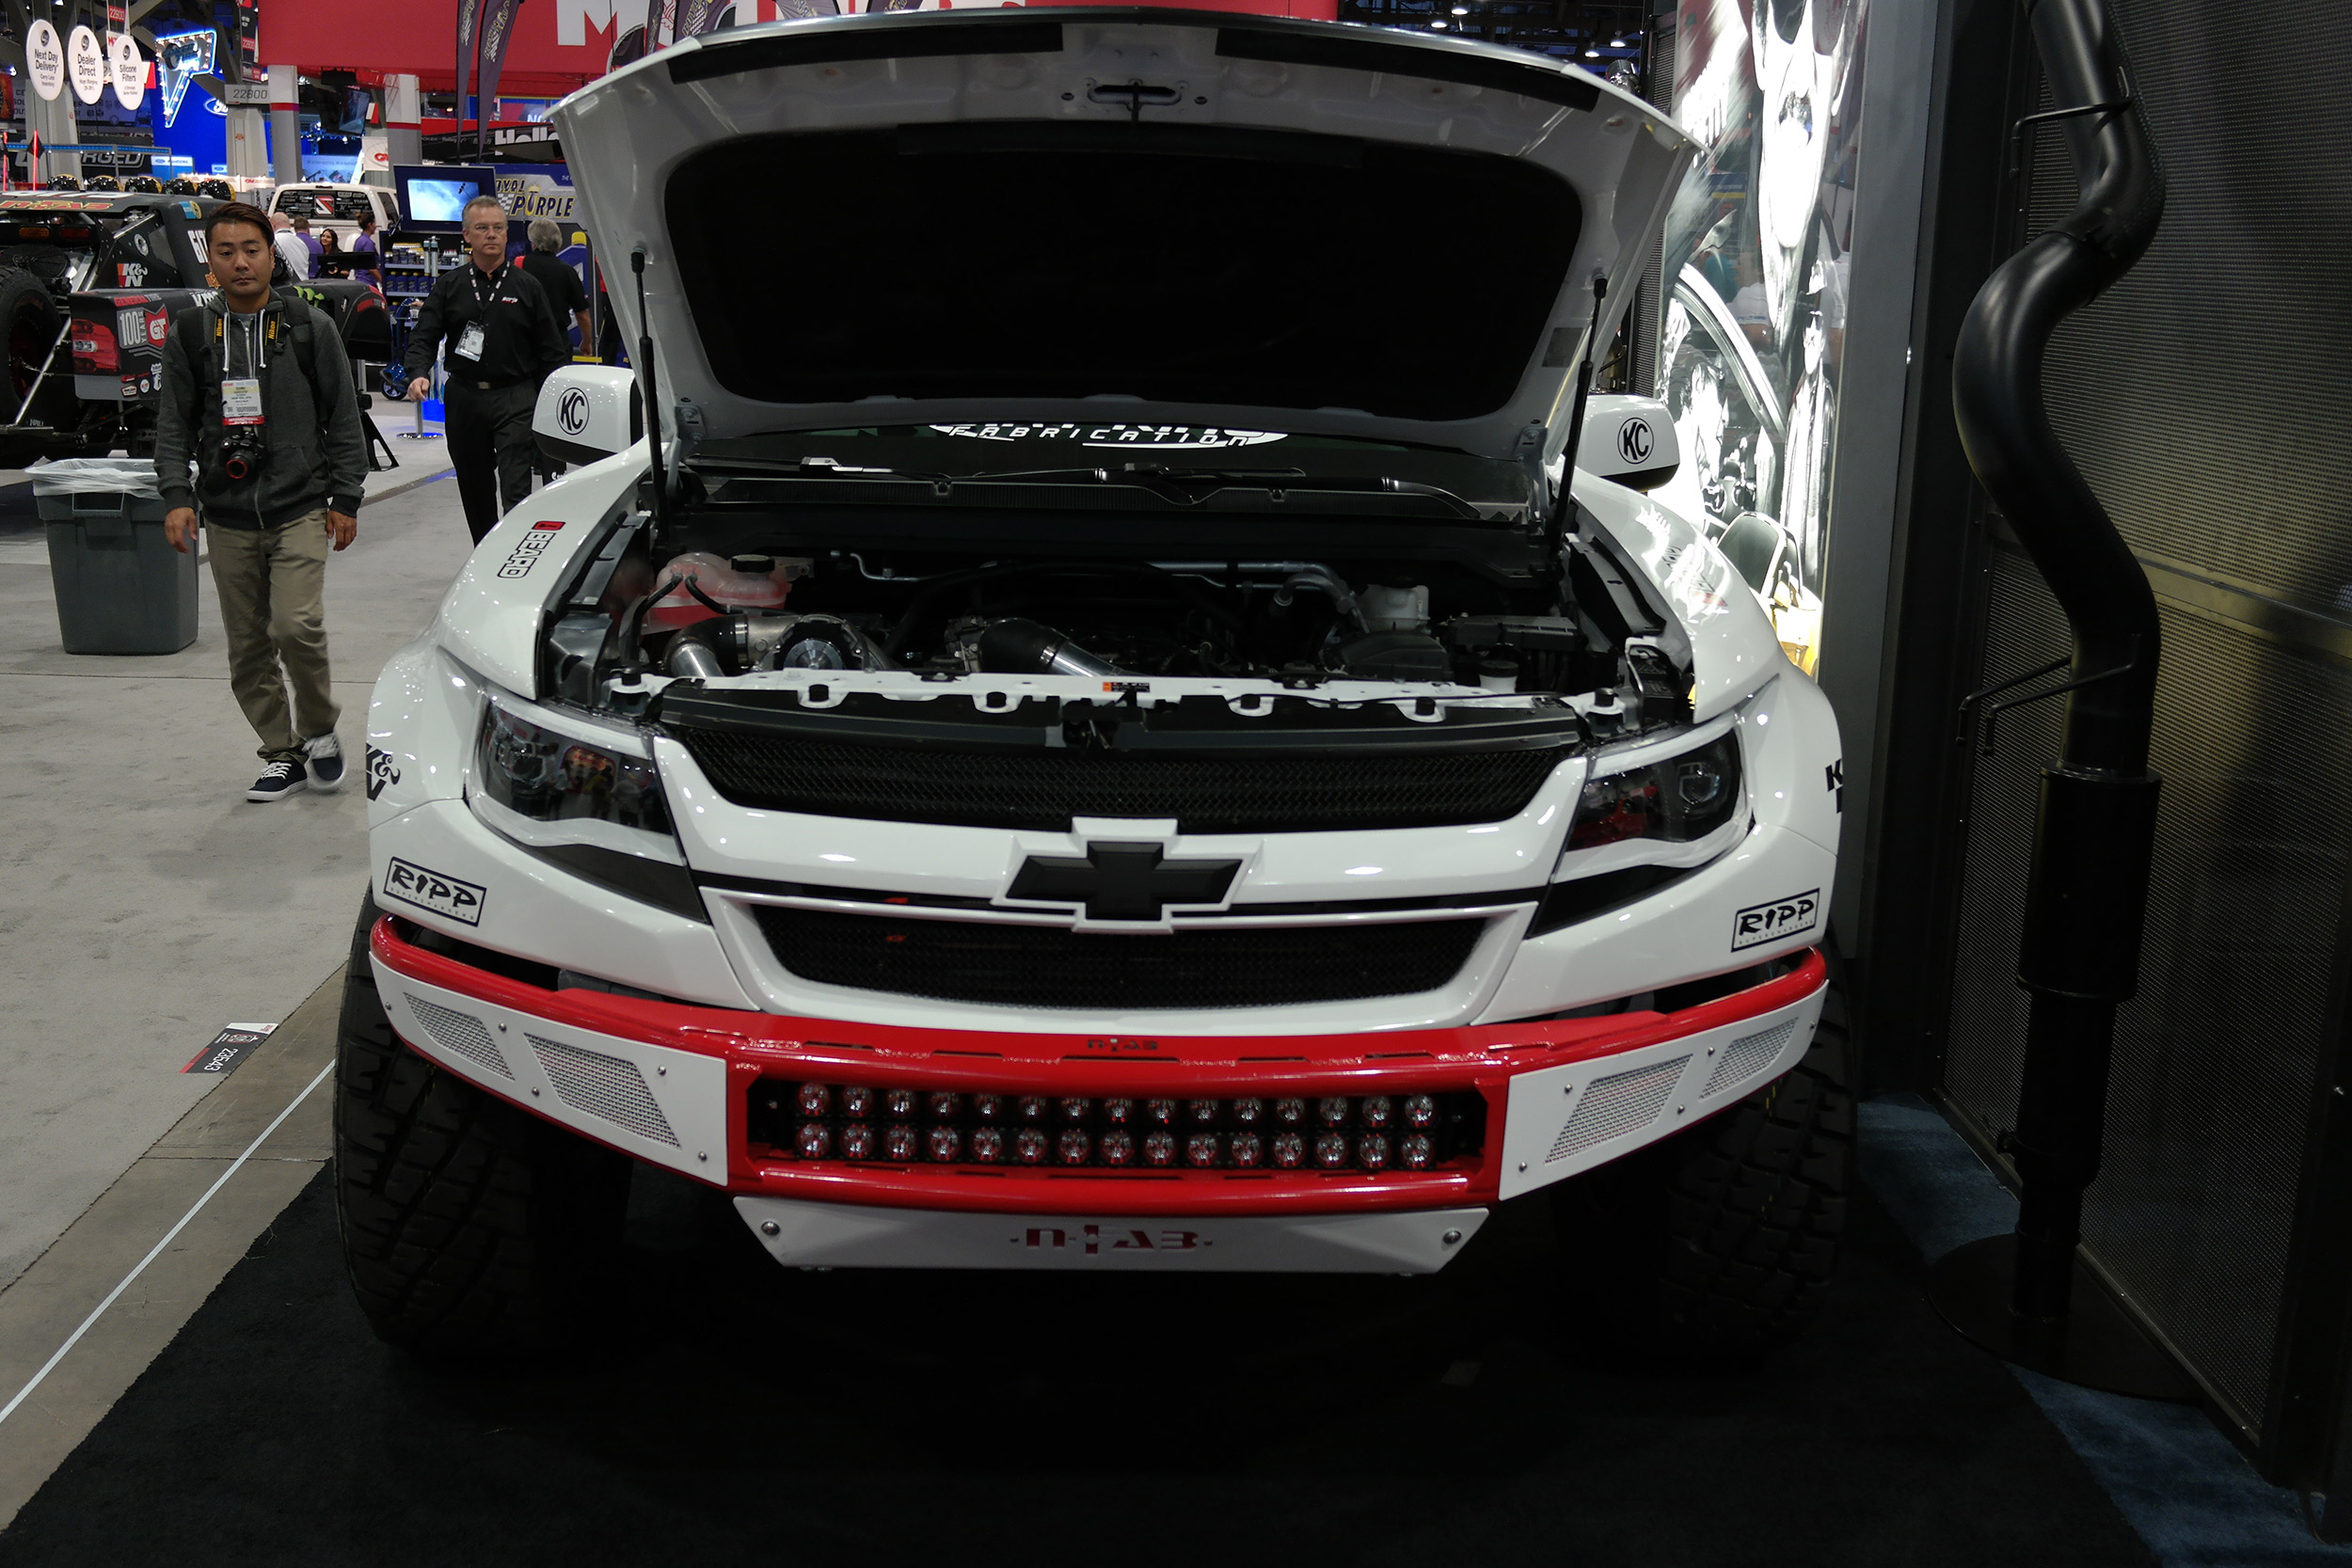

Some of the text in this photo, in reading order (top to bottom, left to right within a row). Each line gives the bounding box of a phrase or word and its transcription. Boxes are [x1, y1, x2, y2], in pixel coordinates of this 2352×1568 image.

[34, 49, 58, 63] Next Day
[77, 54, 96, 66] Dealer
[79, 65, 96, 76] Direct
[119, 65, 136, 73] Silicone
[122, 73, 136, 82] Filters
[233, 88, 268, 100] 22800
[496, 179, 526, 194] OYAL
[509, 194, 576, 218] PURPLE
[113, 294, 149, 308] GENERAL
[119, 311, 141, 346] 100
[138, 310, 148, 343] YEARS
[560, 391, 585, 431] KC
[1622, 421, 1649, 460] KC
[391, 863, 478, 908] RIPP
[1739, 899, 1815, 936] RIPP
